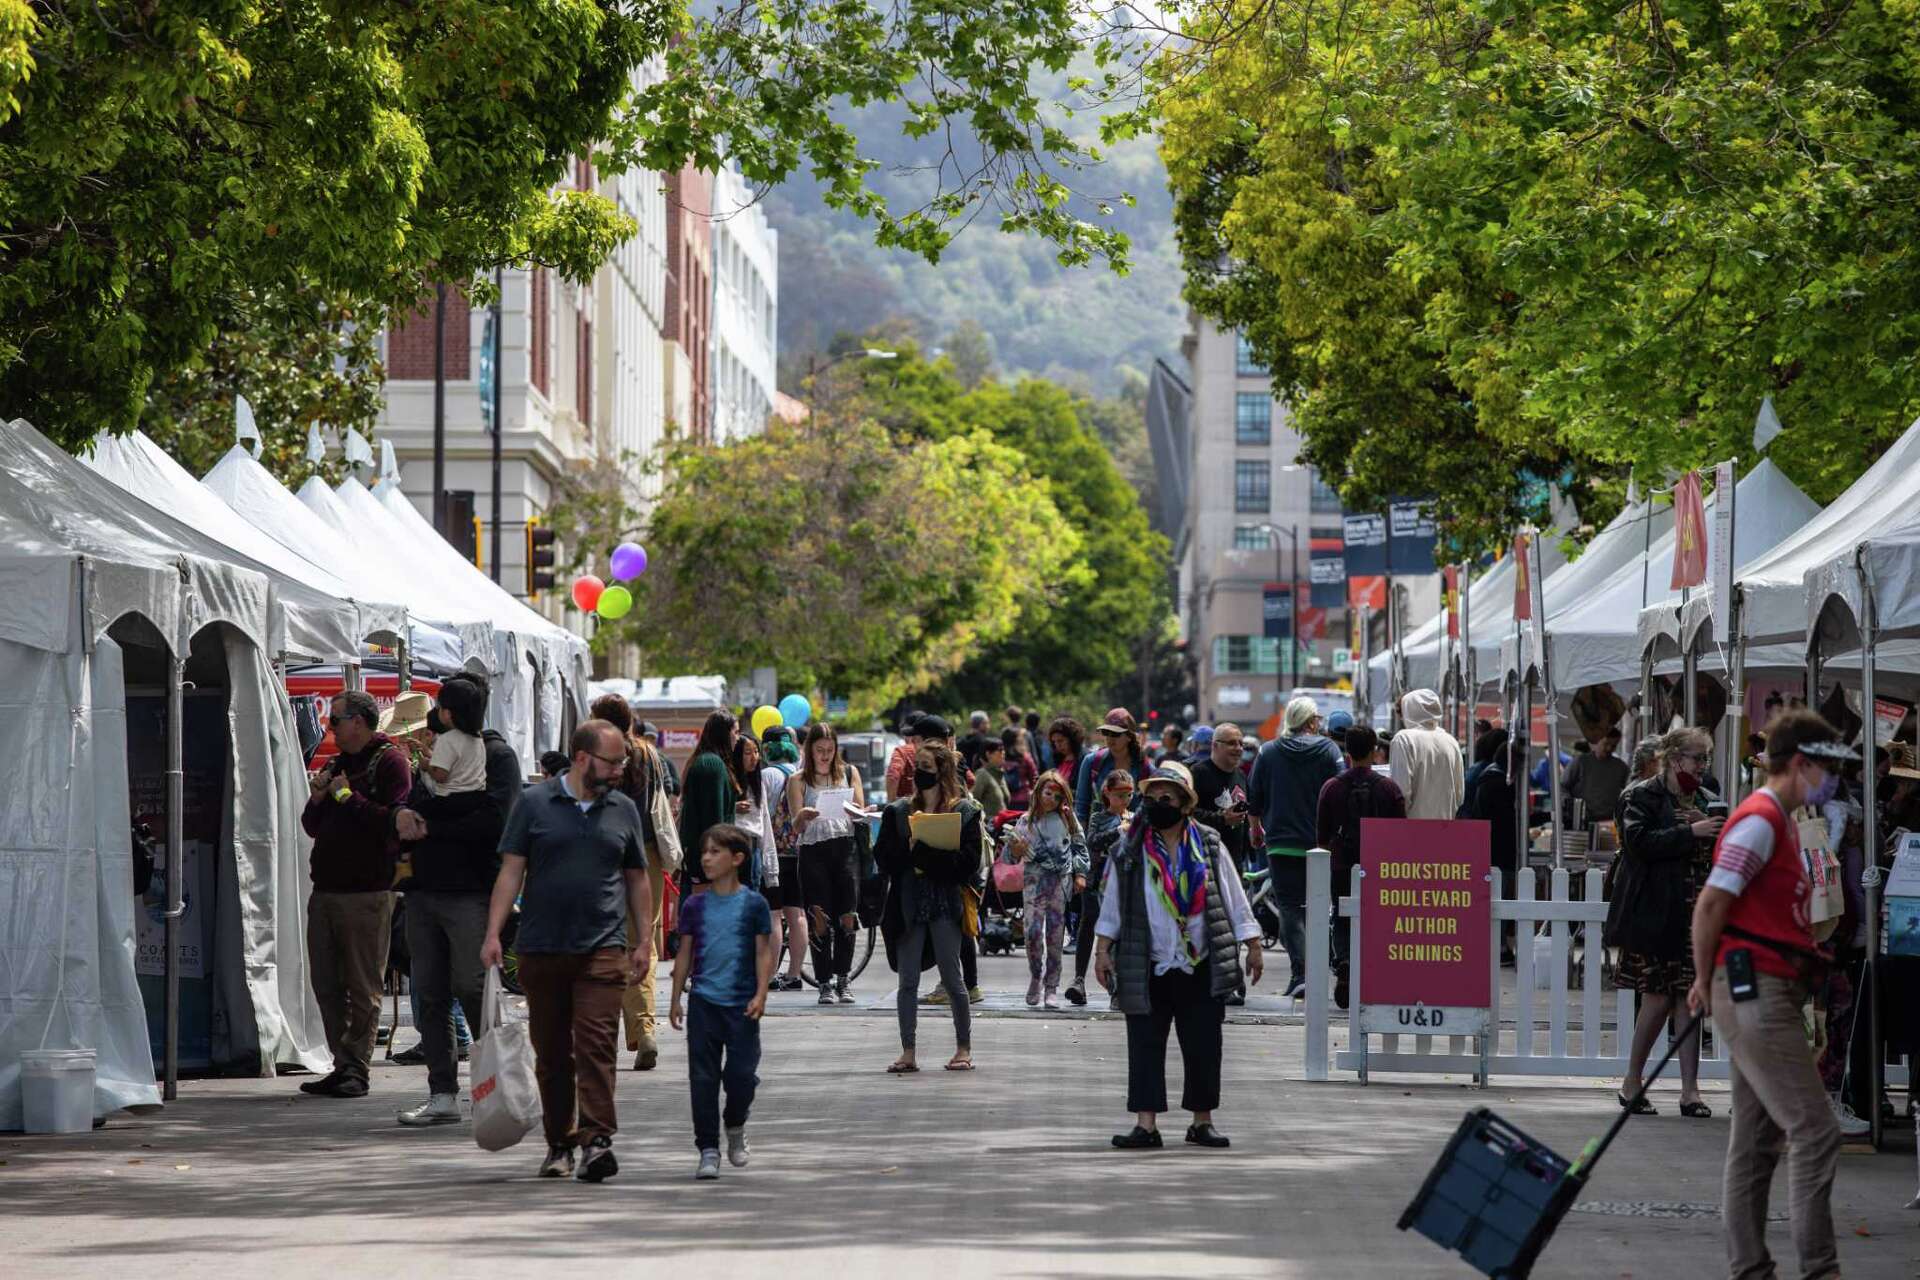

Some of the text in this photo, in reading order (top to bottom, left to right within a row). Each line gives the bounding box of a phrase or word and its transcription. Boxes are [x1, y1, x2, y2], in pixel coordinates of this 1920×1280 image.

[1379, 862, 1471, 880] BOOKSTORE
[1379, 890, 1471, 908] BOULEVARD
[1394, 917, 1457, 935] AUTHOR
[1388, 944, 1463, 962] SIGNINGS
[1398, 1008, 1444, 1027] U&D
